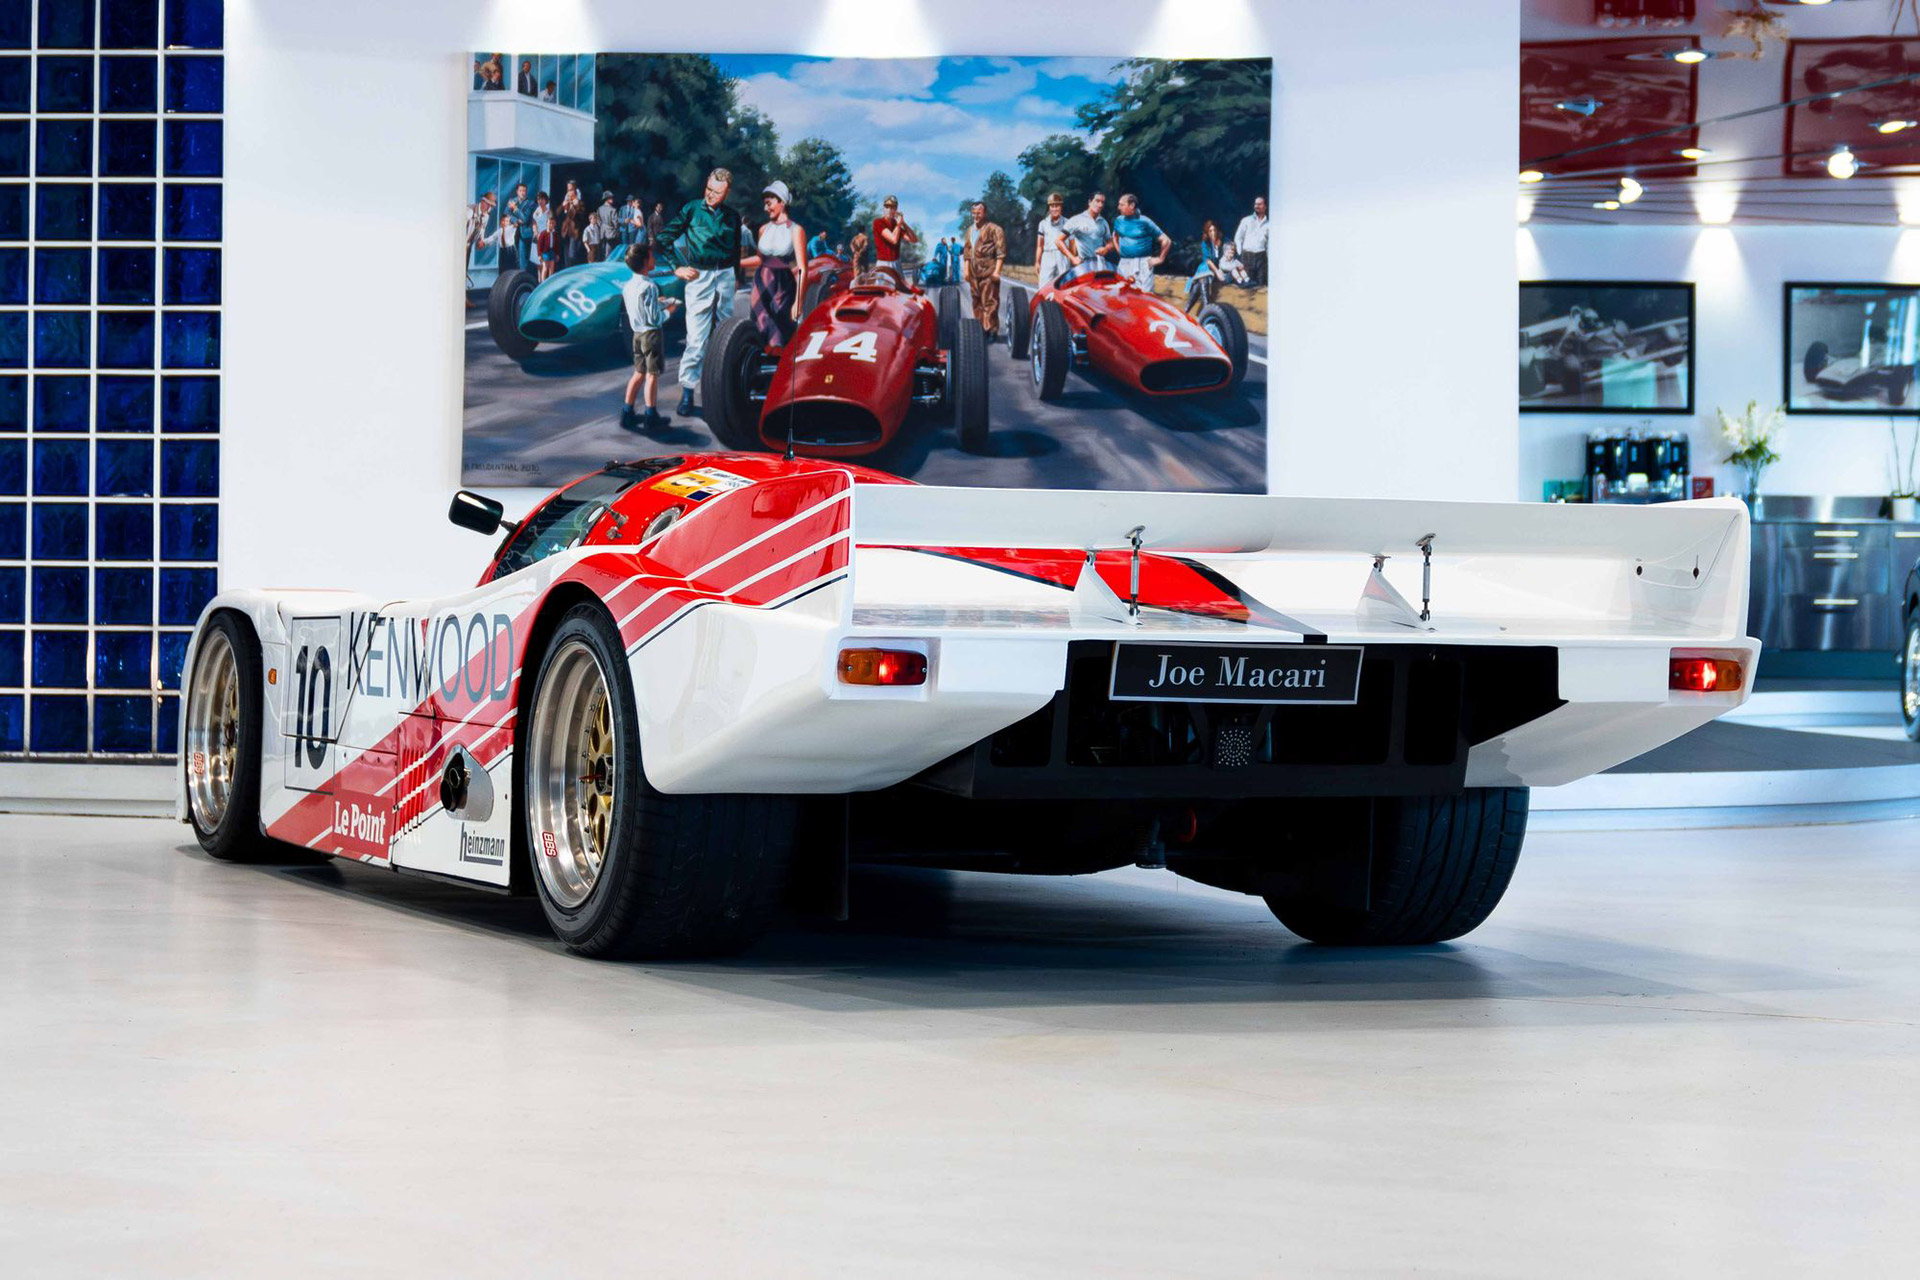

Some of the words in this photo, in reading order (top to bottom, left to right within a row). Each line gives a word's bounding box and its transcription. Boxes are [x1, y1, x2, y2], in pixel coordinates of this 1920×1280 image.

[557, 289, 597, 318] 18
[794, 331, 878, 364] 14
[1149, 320, 1193, 349] 2
[347, 611, 514, 703] KENWOOD
[1148, 654, 1205, 688] Joe
[1215, 655, 1327, 688] Macari
[294, 645, 332, 770] 10
[333, 801, 350, 836] Le
[349, 803, 387, 845] Point
[459, 821, 506, 862] heinzmann
[543, 832, 557, 857] BBS
